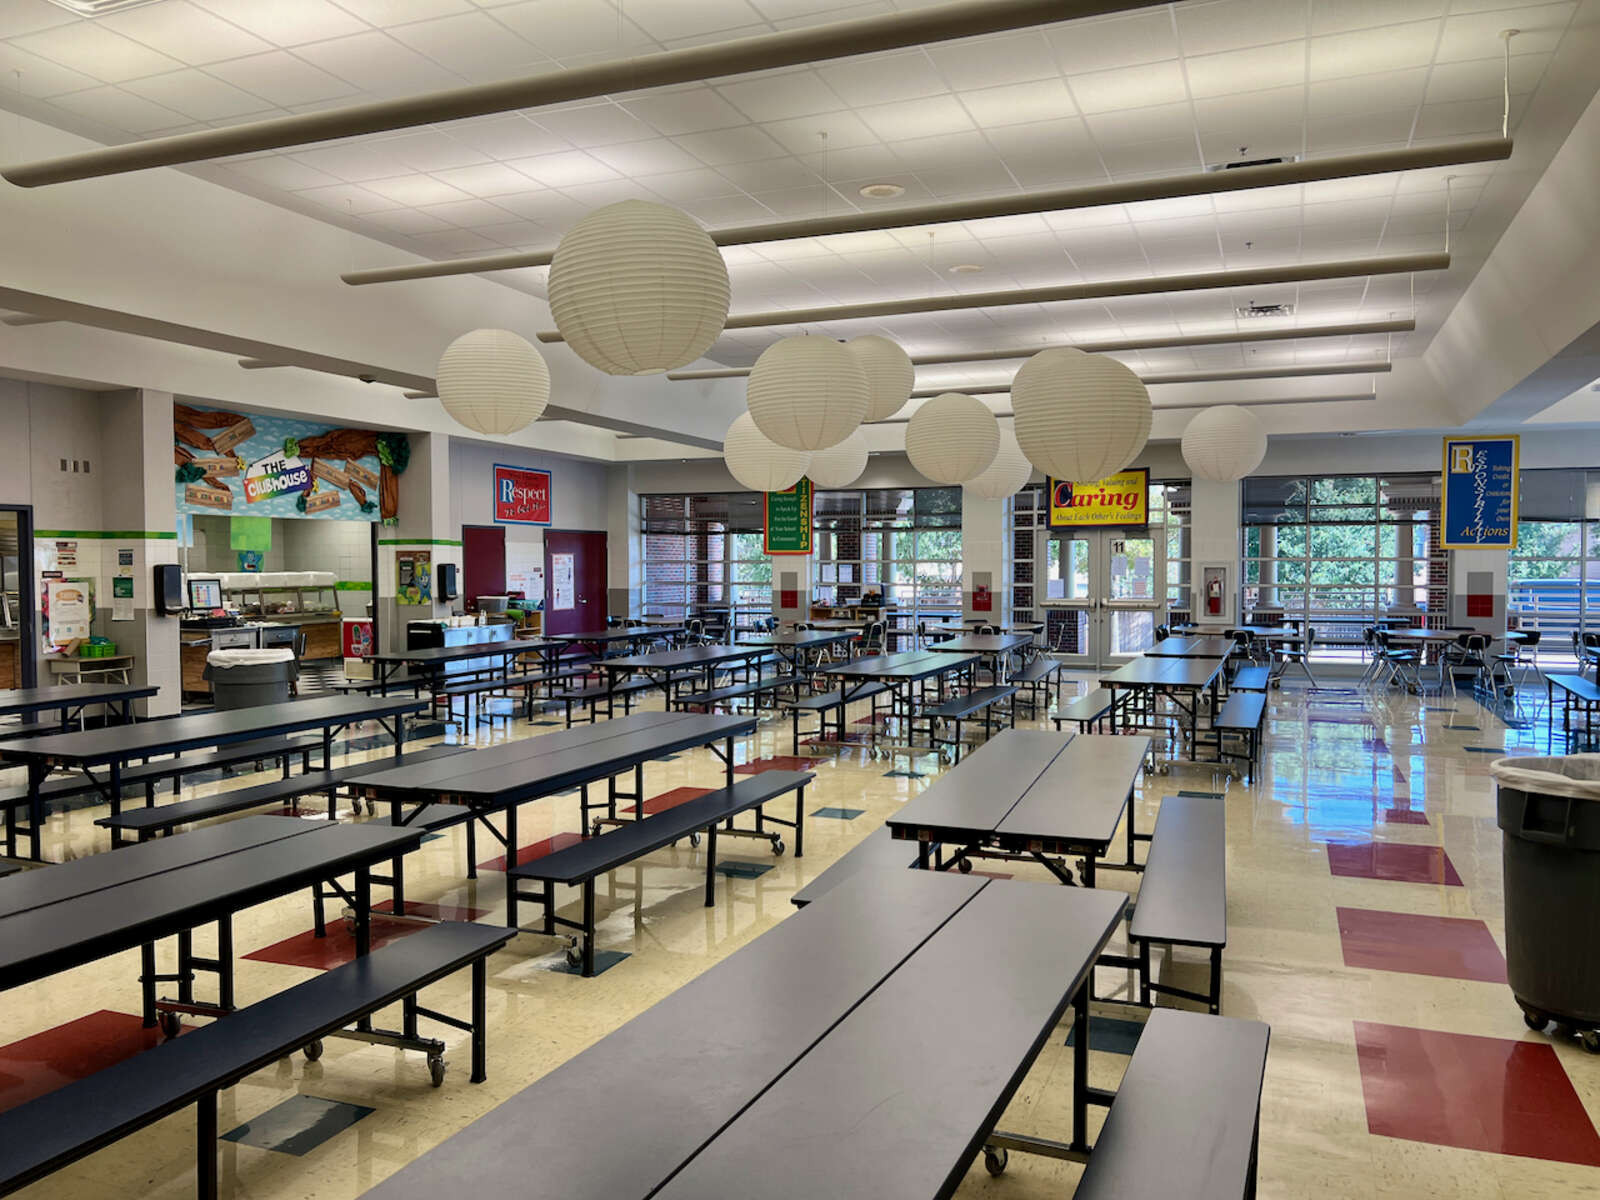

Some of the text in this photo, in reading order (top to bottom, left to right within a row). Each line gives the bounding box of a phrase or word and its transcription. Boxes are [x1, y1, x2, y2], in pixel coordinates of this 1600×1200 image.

[261, 460, 287, 474] THE
[502, 479, 546, 505] Respect
[1054, 482, 1139, 511] Caring
[800, 478, 808, 549] TIZENSHIP
[1460, 525, 1509, 537] Actions
[1114, 542, 1124, 552] 11
